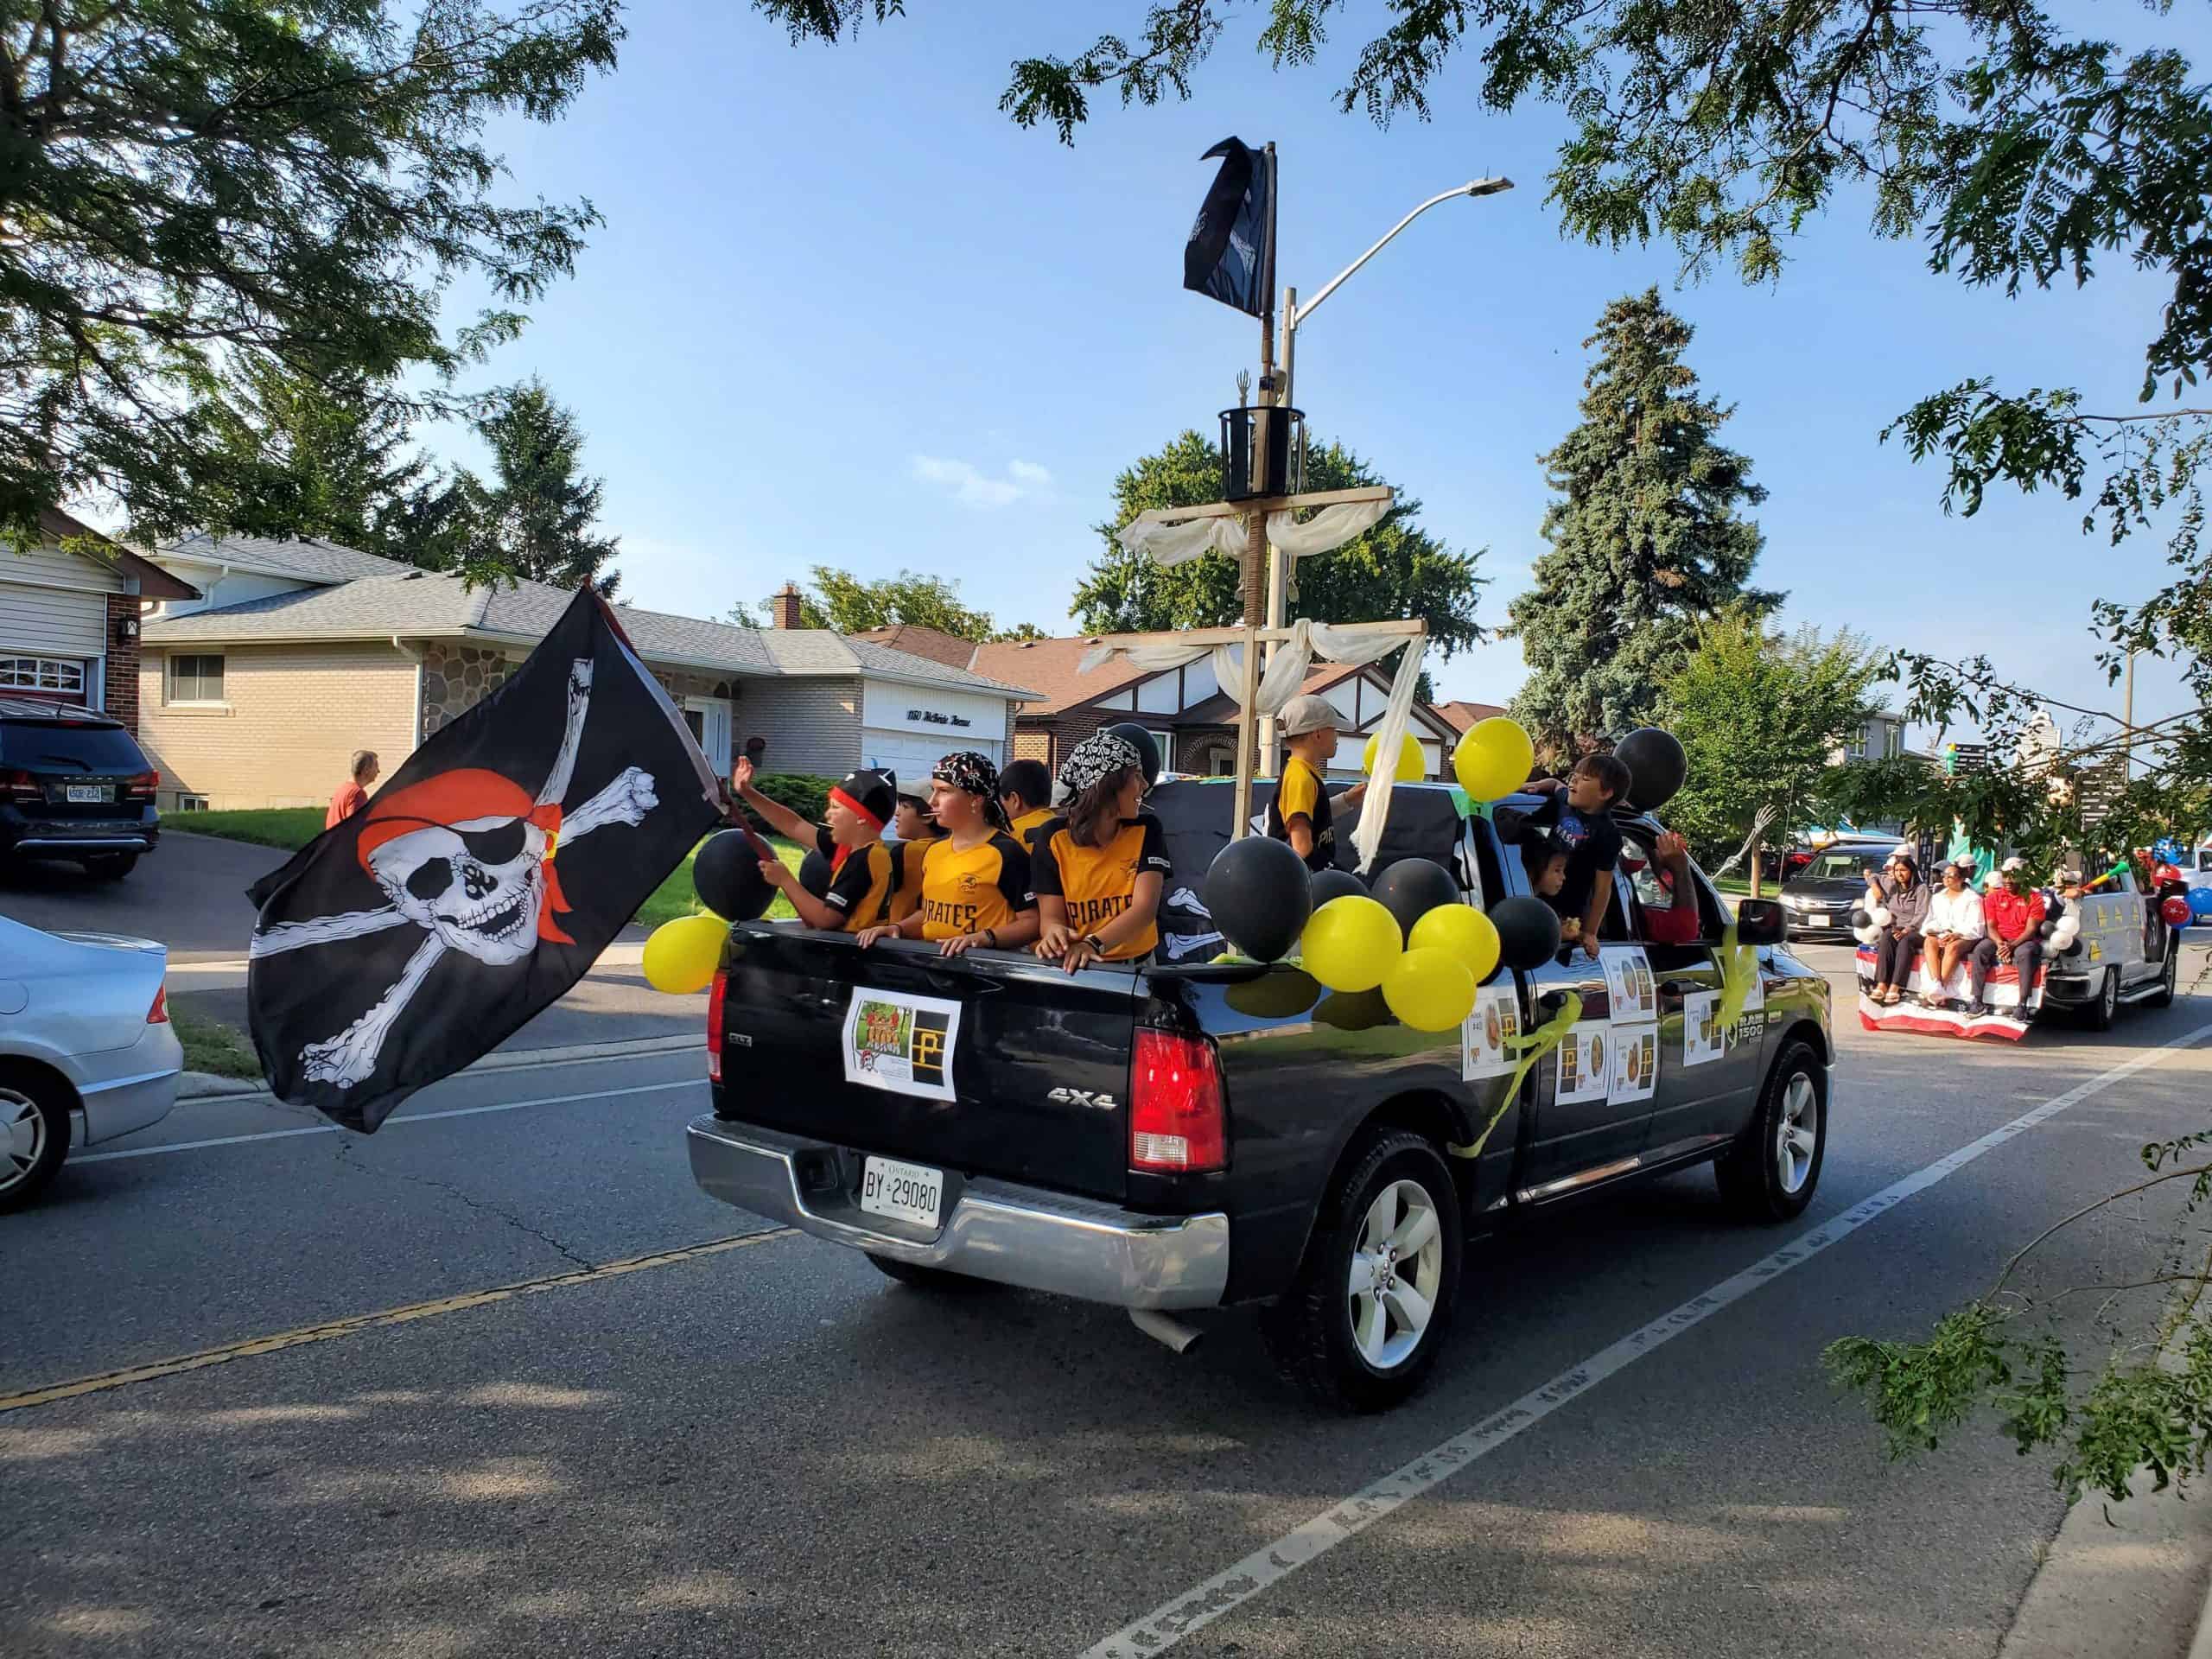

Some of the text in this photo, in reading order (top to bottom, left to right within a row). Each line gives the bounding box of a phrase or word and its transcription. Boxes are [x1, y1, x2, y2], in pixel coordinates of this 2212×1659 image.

[1738, 1012, 1764, 1028] RAM
[1738, 1024, 1764, 1039] 1500
[866, 1171, 885, 1199] BY
[892, 1178, 937, 1212] 29080
